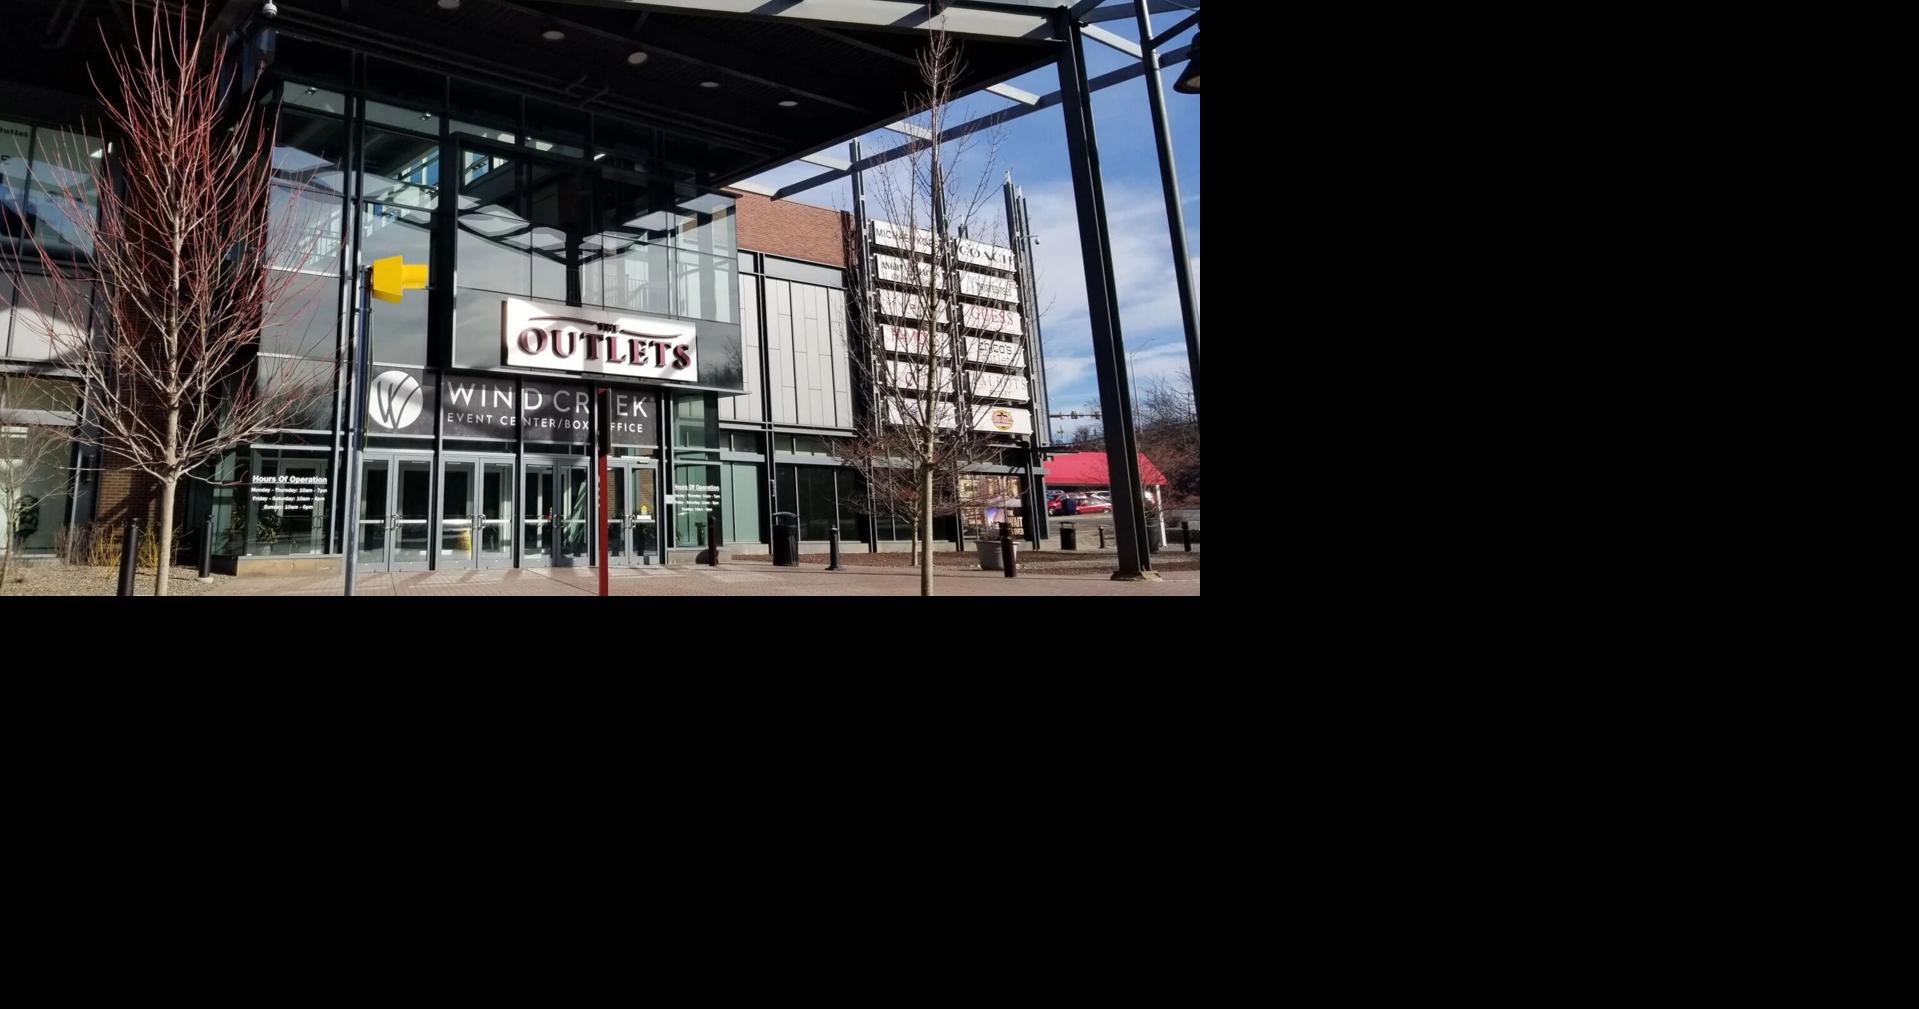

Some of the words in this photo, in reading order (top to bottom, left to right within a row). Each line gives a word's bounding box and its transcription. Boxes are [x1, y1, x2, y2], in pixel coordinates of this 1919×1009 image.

[971, 306, 1013, 326] GUESS
[517, 327, 692, 370] OUTLETS
[447, 381, 543, 411] WIND
[553, 390, 648, 418] CREK
[447, 412, 493, 424] EVENT
[610, 422, 643, 433] FFICE
[252, 474, 277, 484] Hours
[278, 475, 289, 483] Of
[289, 475, 328, 485] Operation
